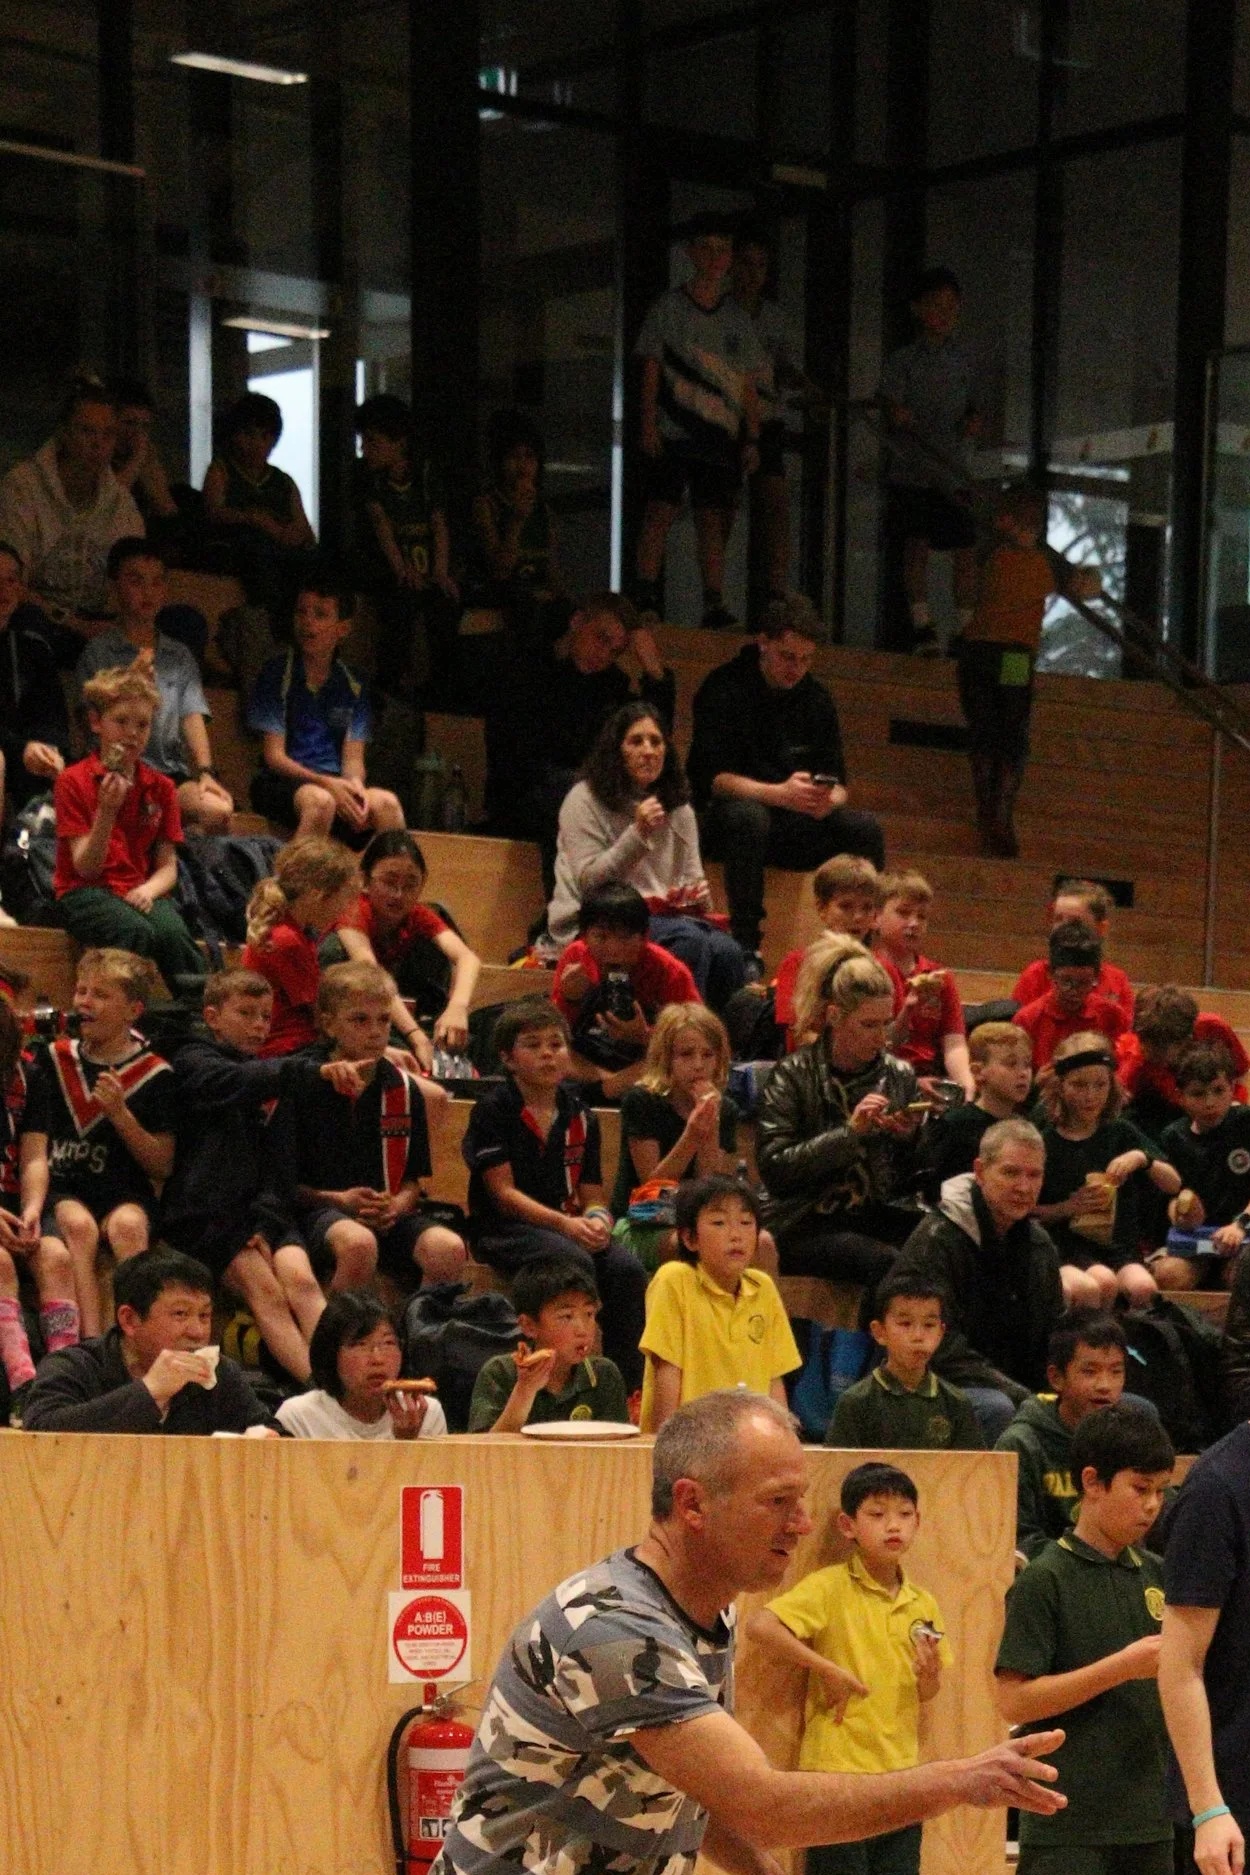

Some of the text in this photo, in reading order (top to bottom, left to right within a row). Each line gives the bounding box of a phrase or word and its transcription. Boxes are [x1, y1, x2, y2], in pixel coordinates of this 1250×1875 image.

[422, 1563, 442, 1573] FIRE
[403, 1573, 461, 1584] EXTINGUISHER
[407, 1623, 454, 1636] POWDER
